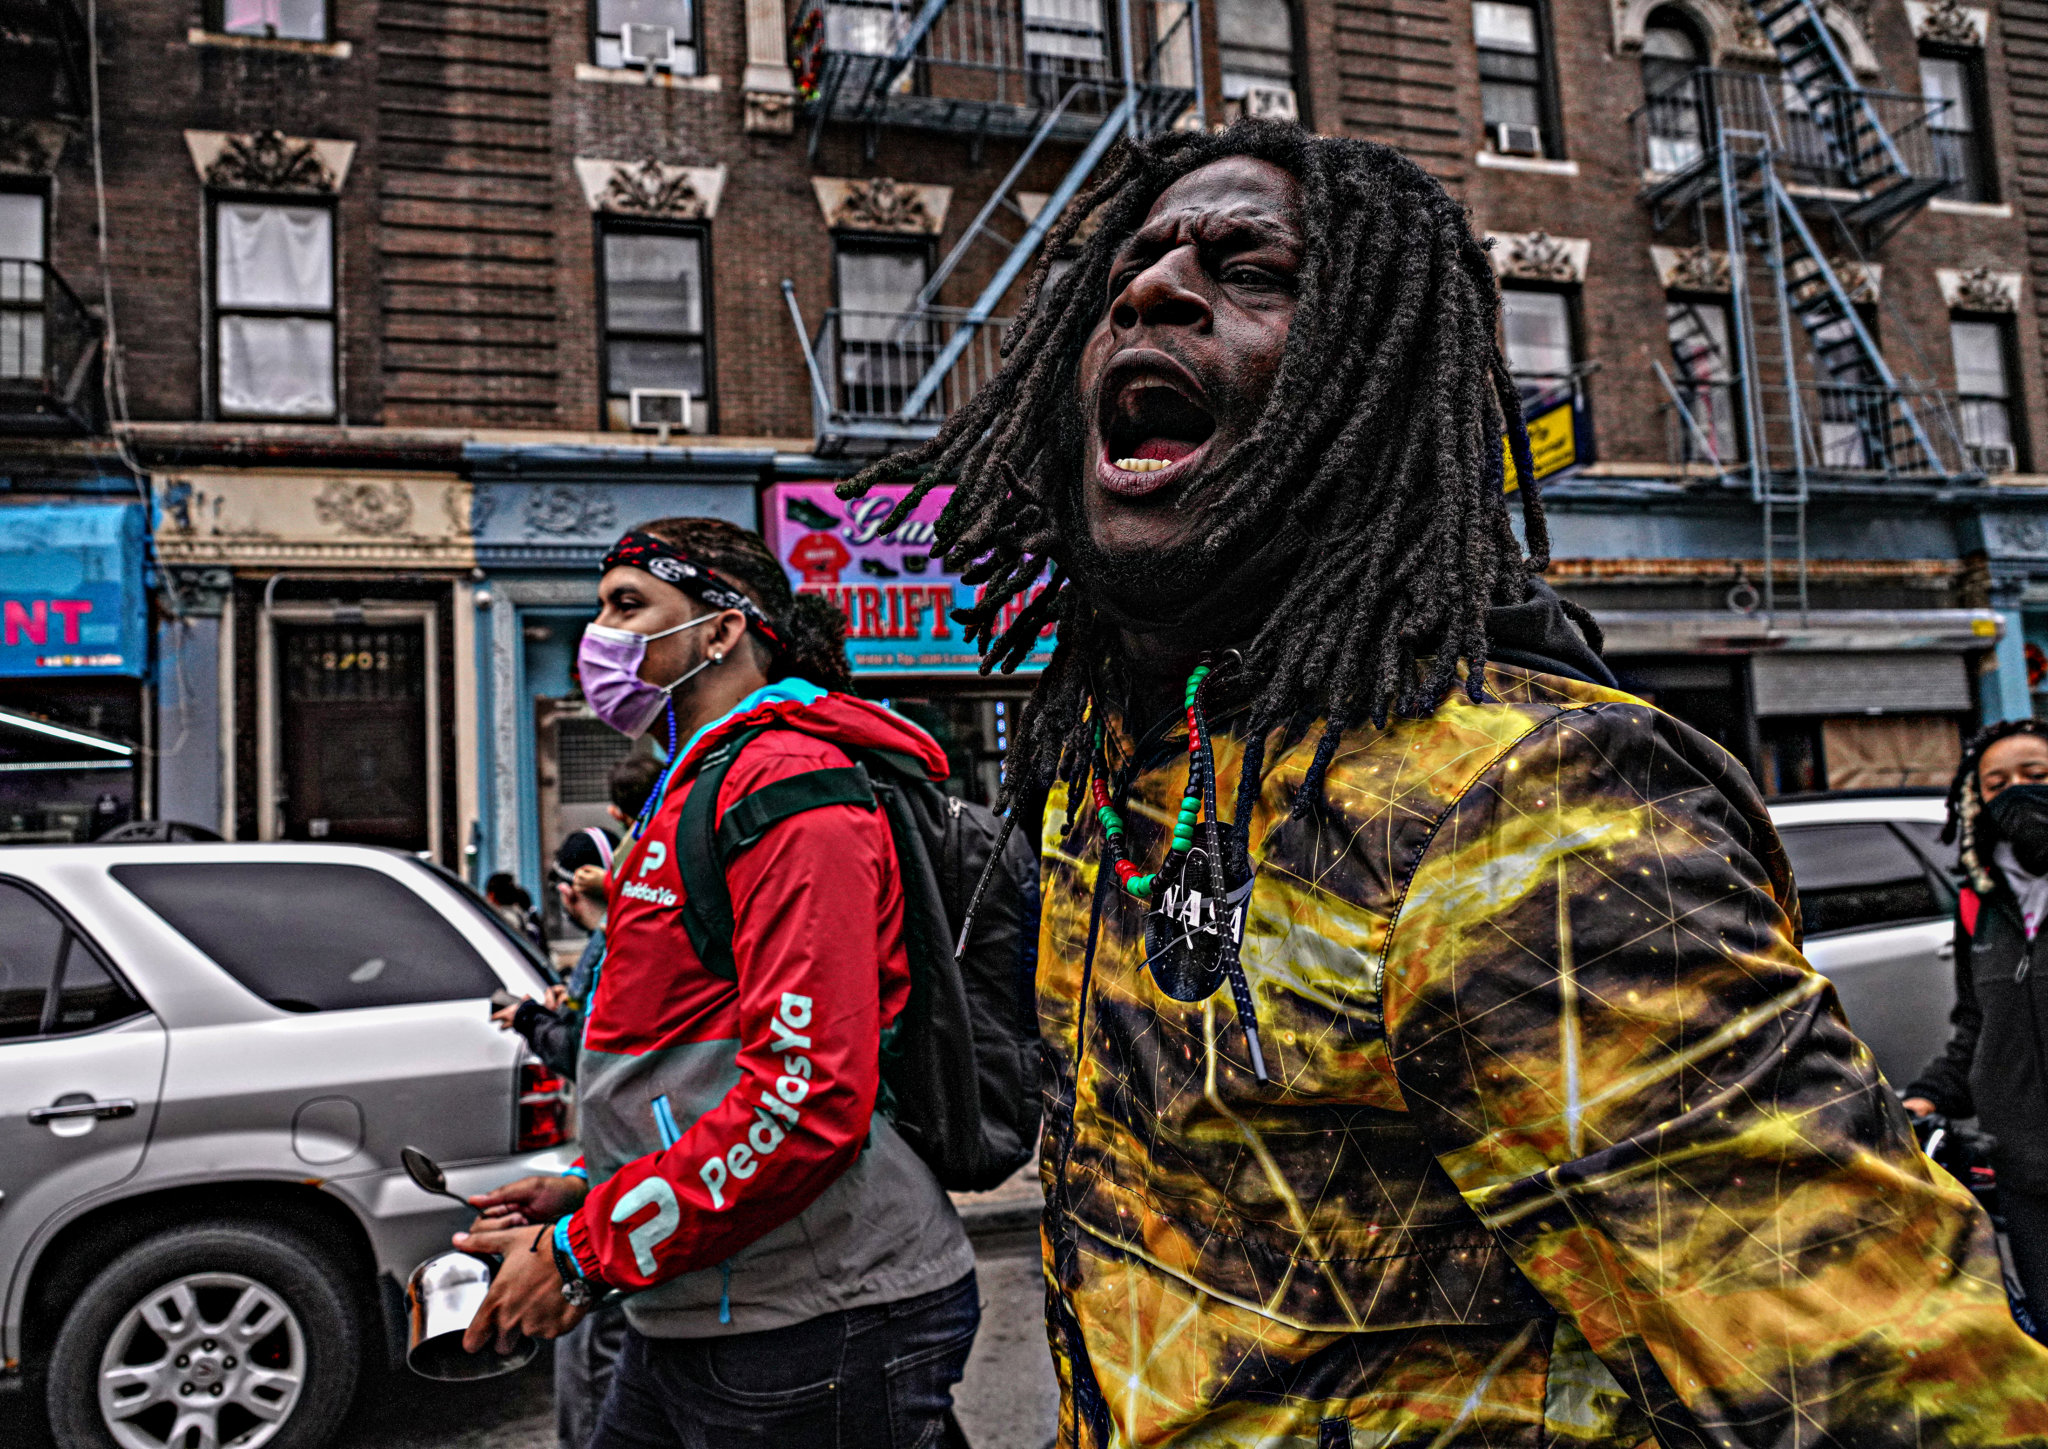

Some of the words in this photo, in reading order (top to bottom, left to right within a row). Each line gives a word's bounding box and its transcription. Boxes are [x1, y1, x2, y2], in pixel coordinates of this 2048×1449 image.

[1, 600, 93, 645] NT
[797, 583, 952, 638] HRIFT
[699, 992, 812, 1210] PeddosYa
